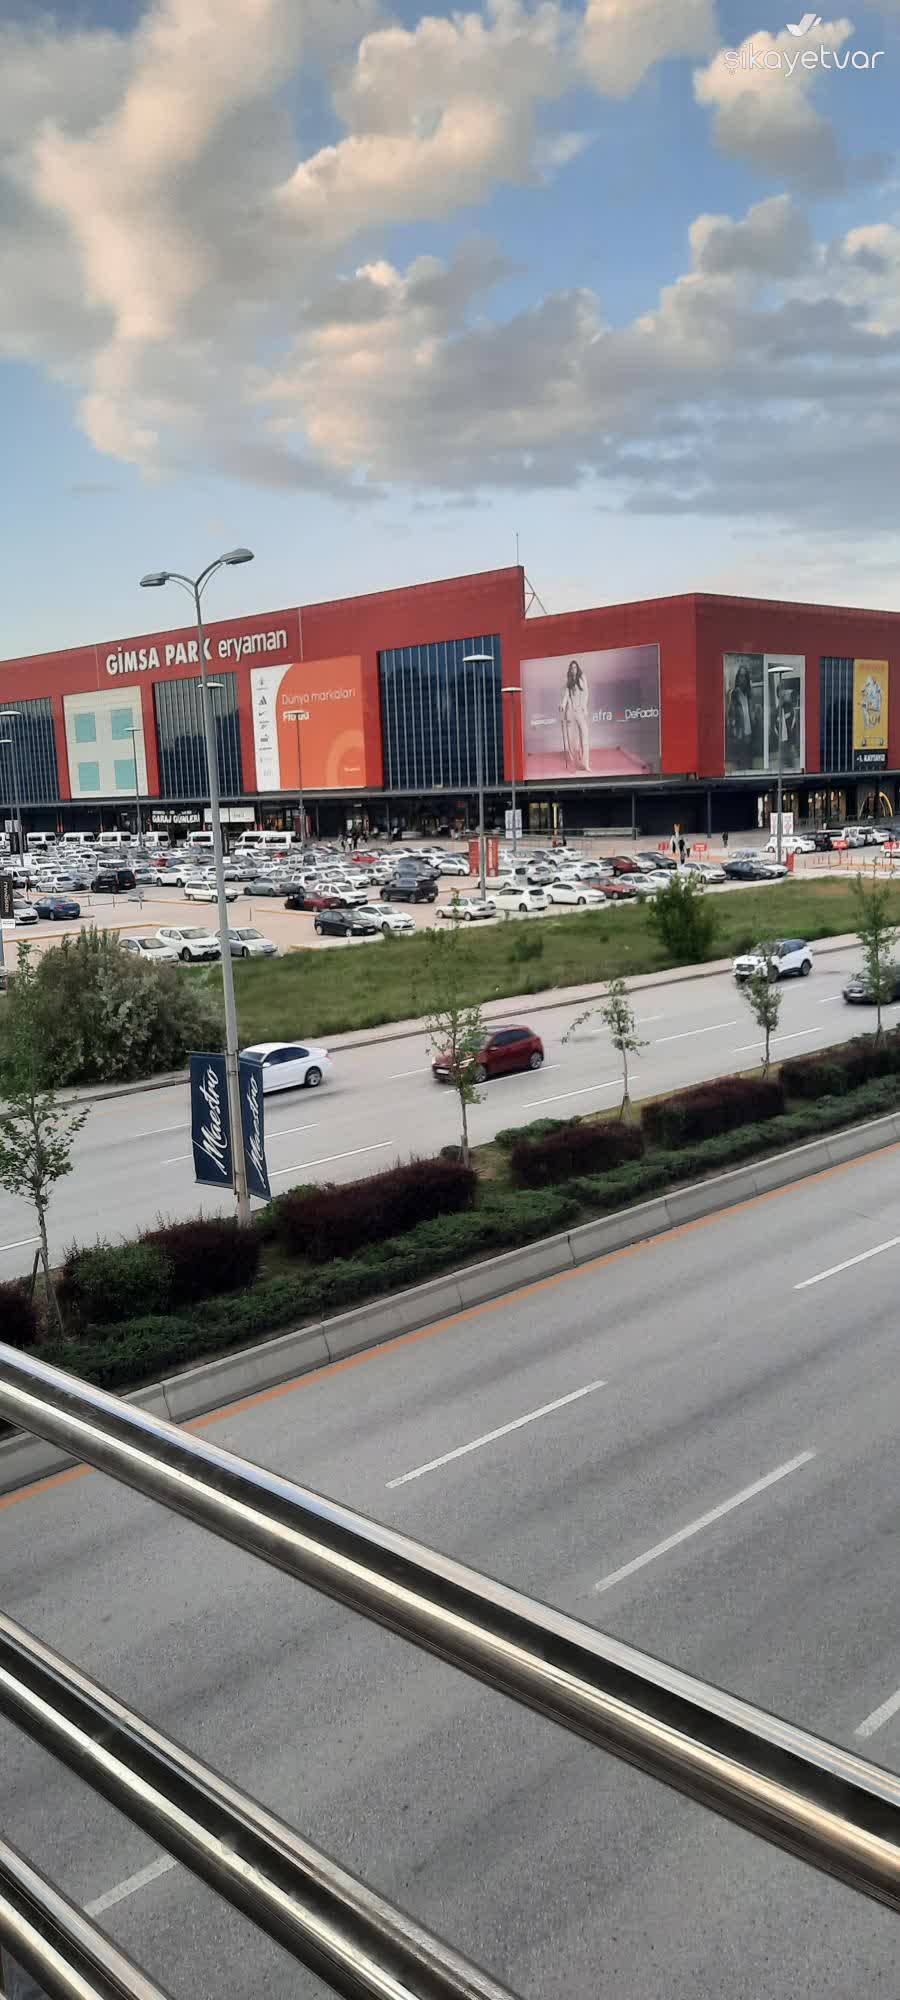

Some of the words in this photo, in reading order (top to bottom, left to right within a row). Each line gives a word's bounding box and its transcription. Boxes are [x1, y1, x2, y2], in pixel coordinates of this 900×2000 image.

[106, 647, 160, 675] GİMSA
[165, 638, 212, 666] PARK
[218, 630, 287, 661] eryaman
[624, 706, 659, 720] DeFacto
[193, 1063, 228, 1176] Maestro
[246, 1074, 267, 1189] Maestro
